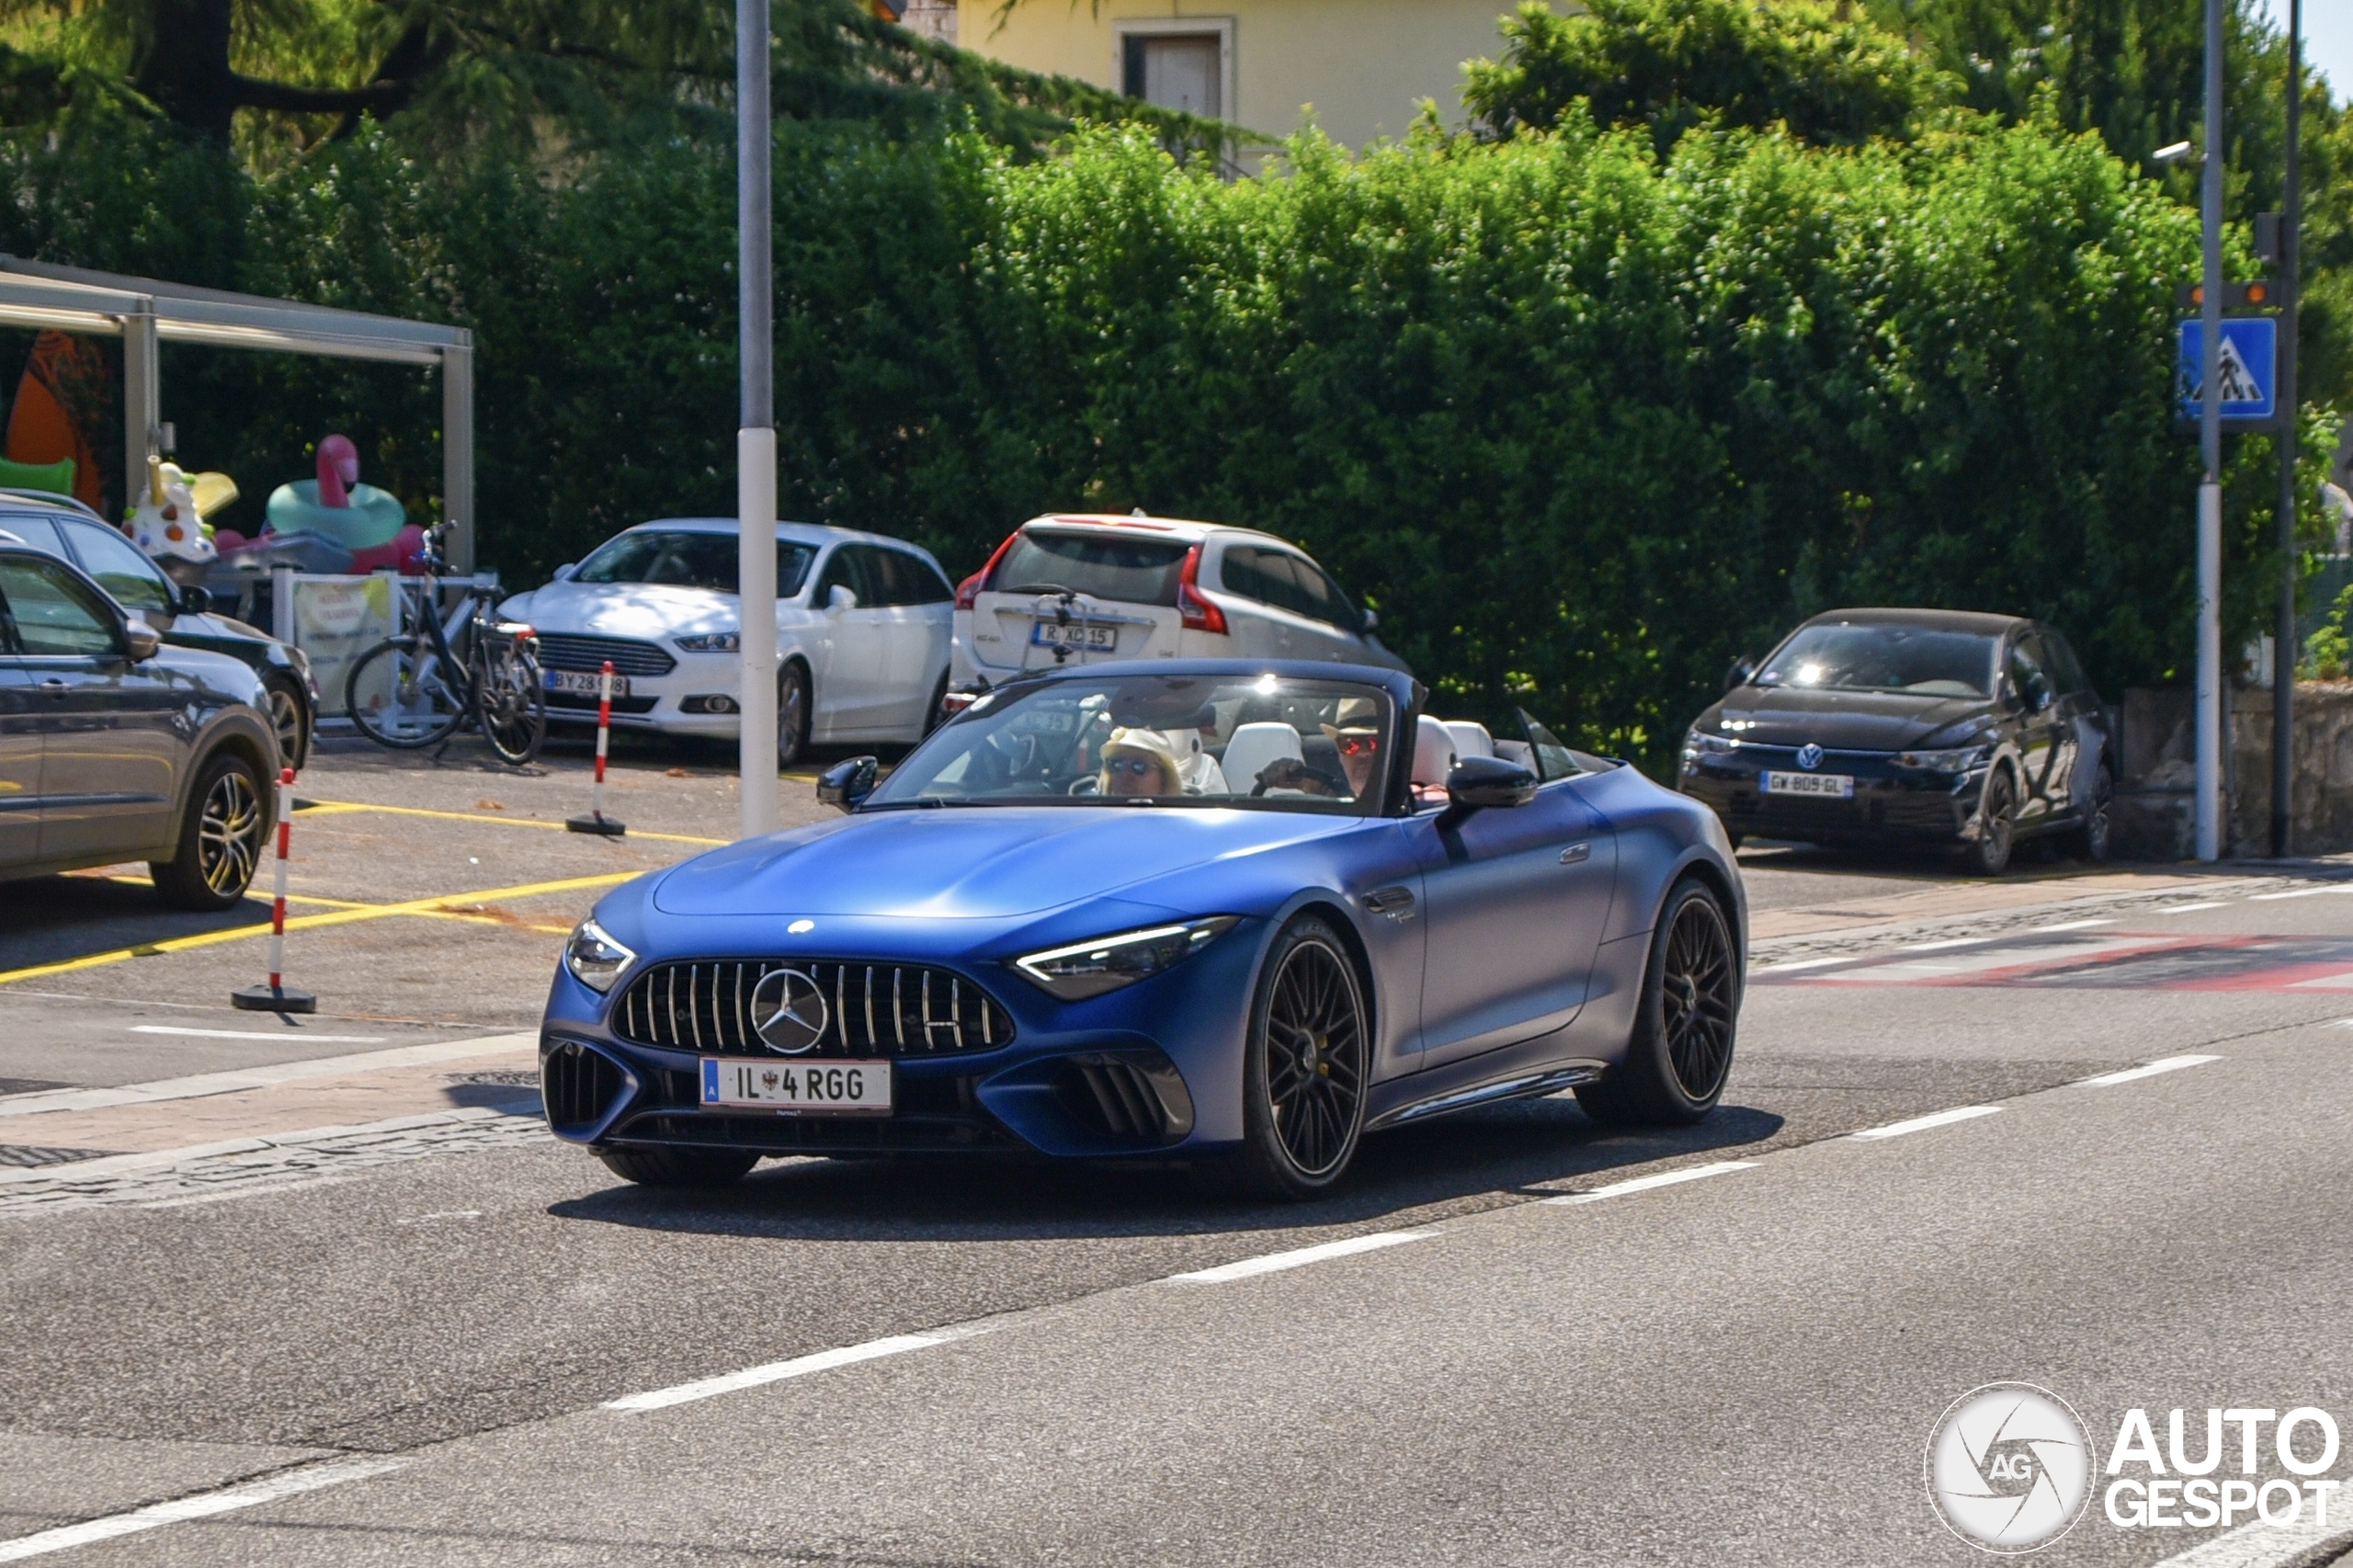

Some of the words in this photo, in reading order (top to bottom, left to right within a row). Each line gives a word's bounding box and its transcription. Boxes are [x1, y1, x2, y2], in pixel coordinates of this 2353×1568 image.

[1046, 626, 1056, 640] R
[1064, 627, 1083, 642] XC
[1088, 629, 1107, 644] 15
[555, 673, 574, 687] BY
[577, 675, 595, 690] 28
[708, 1085, 715, 1096] A
[737, 1067, 760, 1098] IL
[782, 1068, 798, 1100] 4
[806, 1068, 864, 1100] RGG
